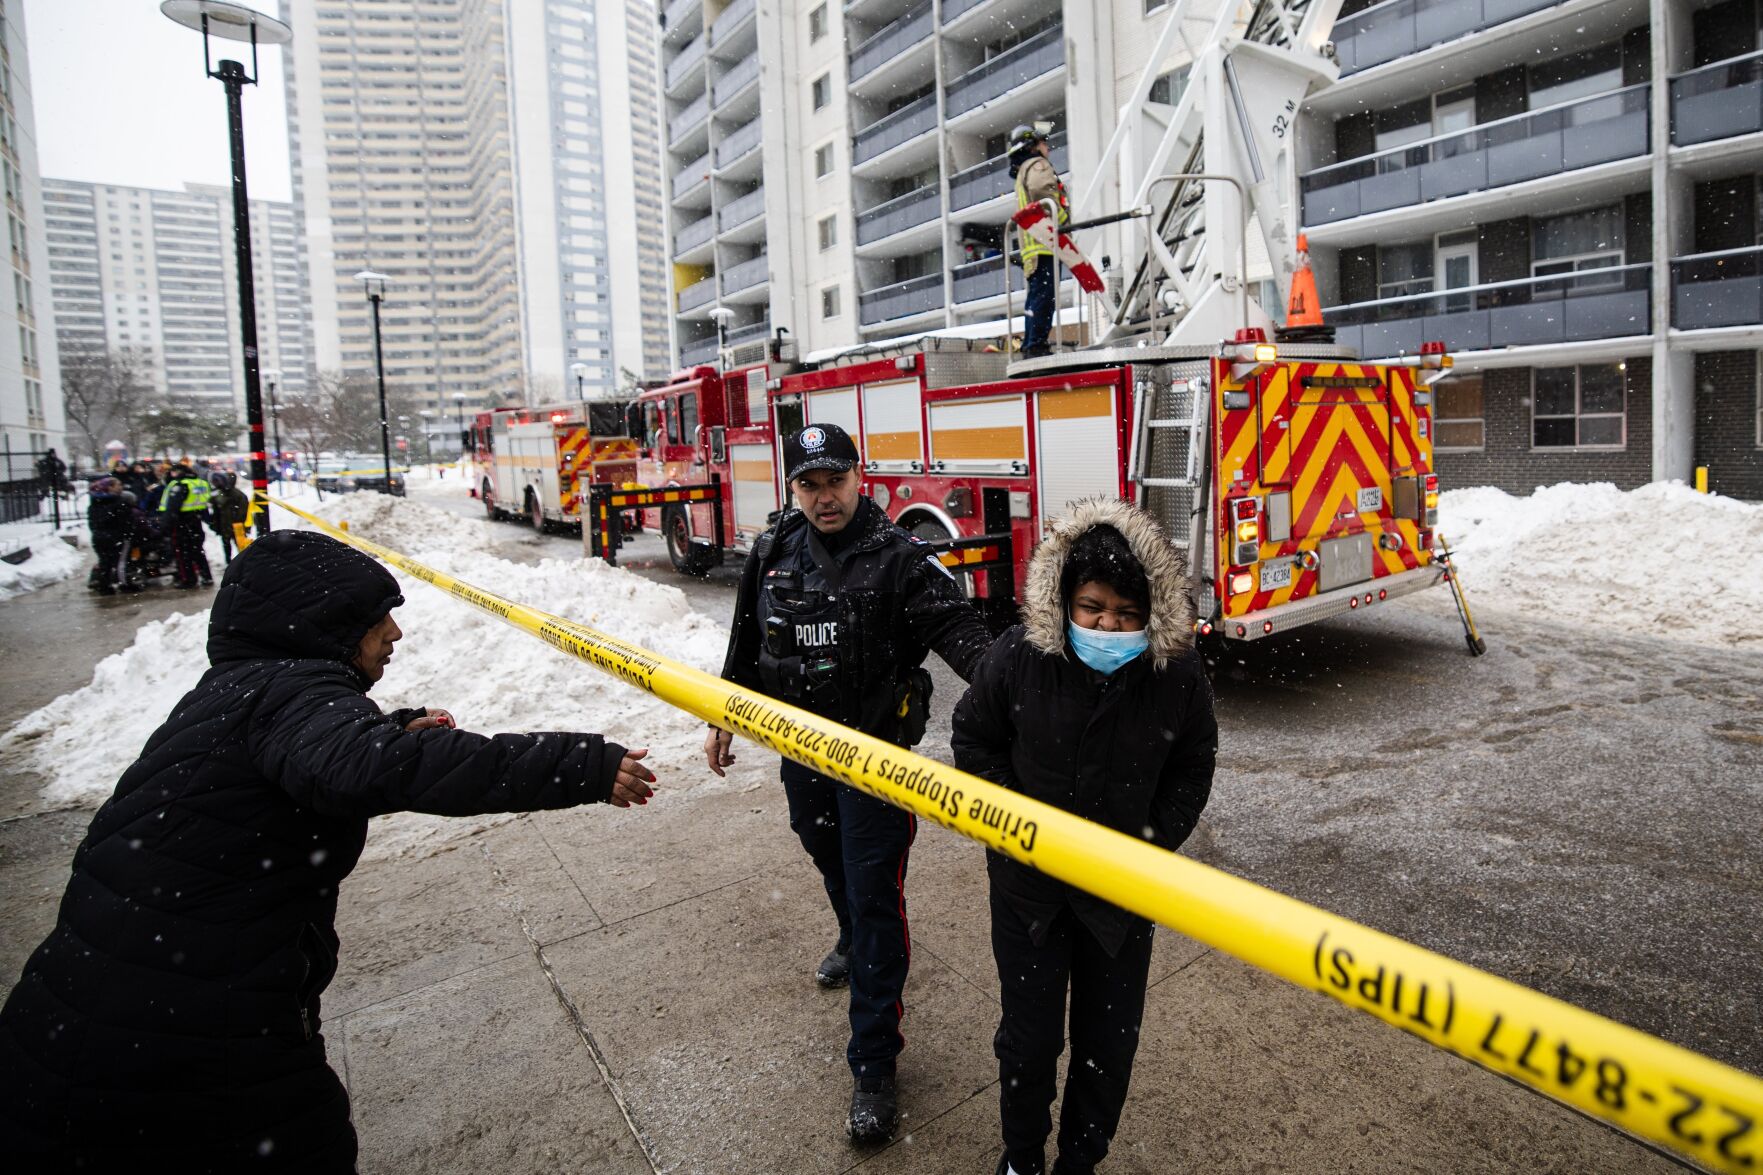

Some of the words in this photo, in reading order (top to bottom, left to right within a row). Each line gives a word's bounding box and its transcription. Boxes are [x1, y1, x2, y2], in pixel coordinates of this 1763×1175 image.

[1272, 115, 1289, 138] 32
[1285, 100, 1297, 112] M
[795, 621, 838, 647] POLICE
[725, 694, 766, 724] (TIPS)
[760, 709, 874, 775] 1-800-222-8477
[877, 758, 964, 818] Stoppers
[969, 798, 1038, 852] Crime
[1313, 931, 1457, 1036] (TIPS)
[1480, 1013, 1757, 1167] 22-8477
